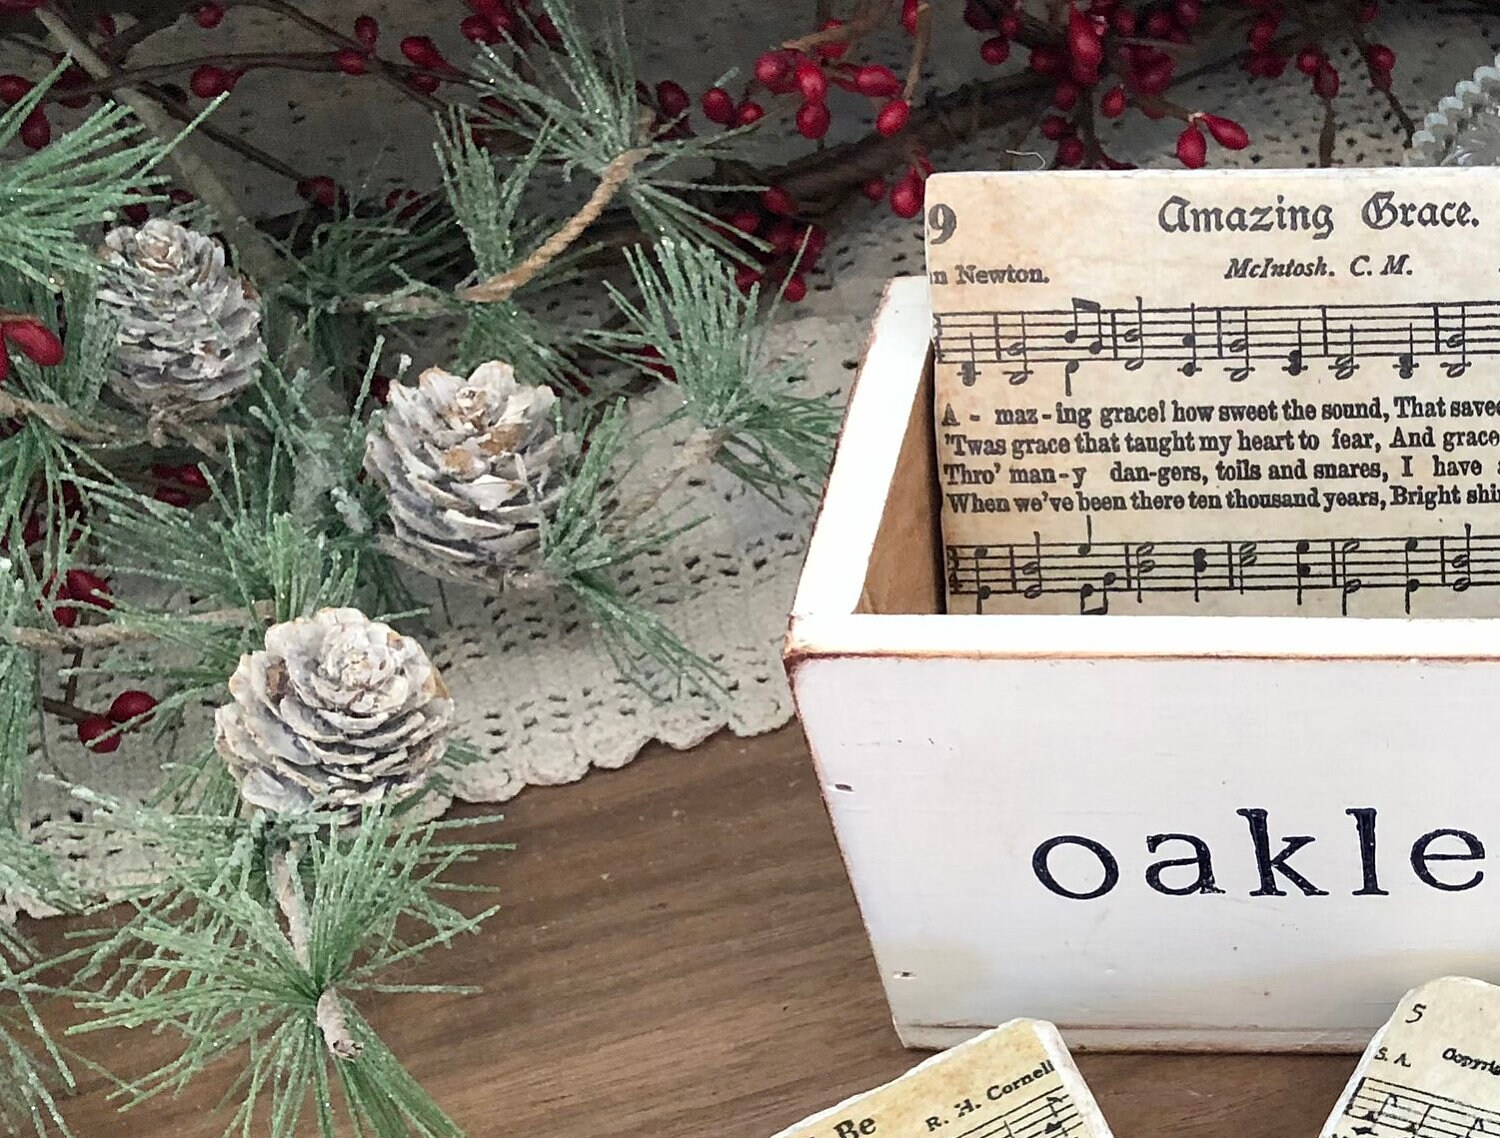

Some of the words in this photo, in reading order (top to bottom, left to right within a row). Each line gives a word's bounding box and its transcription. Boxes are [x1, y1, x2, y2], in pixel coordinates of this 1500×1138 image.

[928, 203, 958, 245] 9
[1158, 194, 1335, 241] Amazing
[1361, 190, 1480, 231] Grace.
[954, 263, 1050, 286] Newton.
[1223, 255, 1335, 280] McIntosh.
[1349, 254, 1373, 277] C.
[1379, 254, 1413, 276] M.
[1099, 399, 1166, 430] grace!
[1170, 399, 1215, 423] how
[1217, 399, 1279, 422] sweet
[1281, 398, 1317, 422] the
[1321, 396, 1390, 424] sound,
[1393, 395, 1447, 419] That
[1010, 436, 1071, 461] grace
[1073, 431, 1121, 454] that
[1123, 430, 1196, 458] taught
[1198, 435, 1233, 457] my
[1236, 429, 1295, 452] heart
[1297, 429, 1320, 451] to
[1331, 427, 1382, 454] fear,
[1388, 425, 1436, 449] And
[1442, 429, 1500, 453] grace
[1214, 458, 1262, 482] toils
[1268, 458, 1308, 481] and
[1313, 462, 1389, 483] snares,
[1400, 455, 1414, 478] I
[1431, 454, 1483, 477] have
[946, 492, 1011, 514] When
[1012, 490, 1074, 513] we've
[1075, 490, 1128, 512] been
[1129, 489, 1185, 511] there
[1187, 488, 1223, 510] ten
[1224, 486, 1321, 509] thousand
[1322, 491, 1387, 513] years,
[1388, 484, 1462, 511] Bright
[1404, 1003, 1427, 1024] 5
[925, 1116, 950, 1132] R.
[986, 1059, 1056, 1101] Cornell
